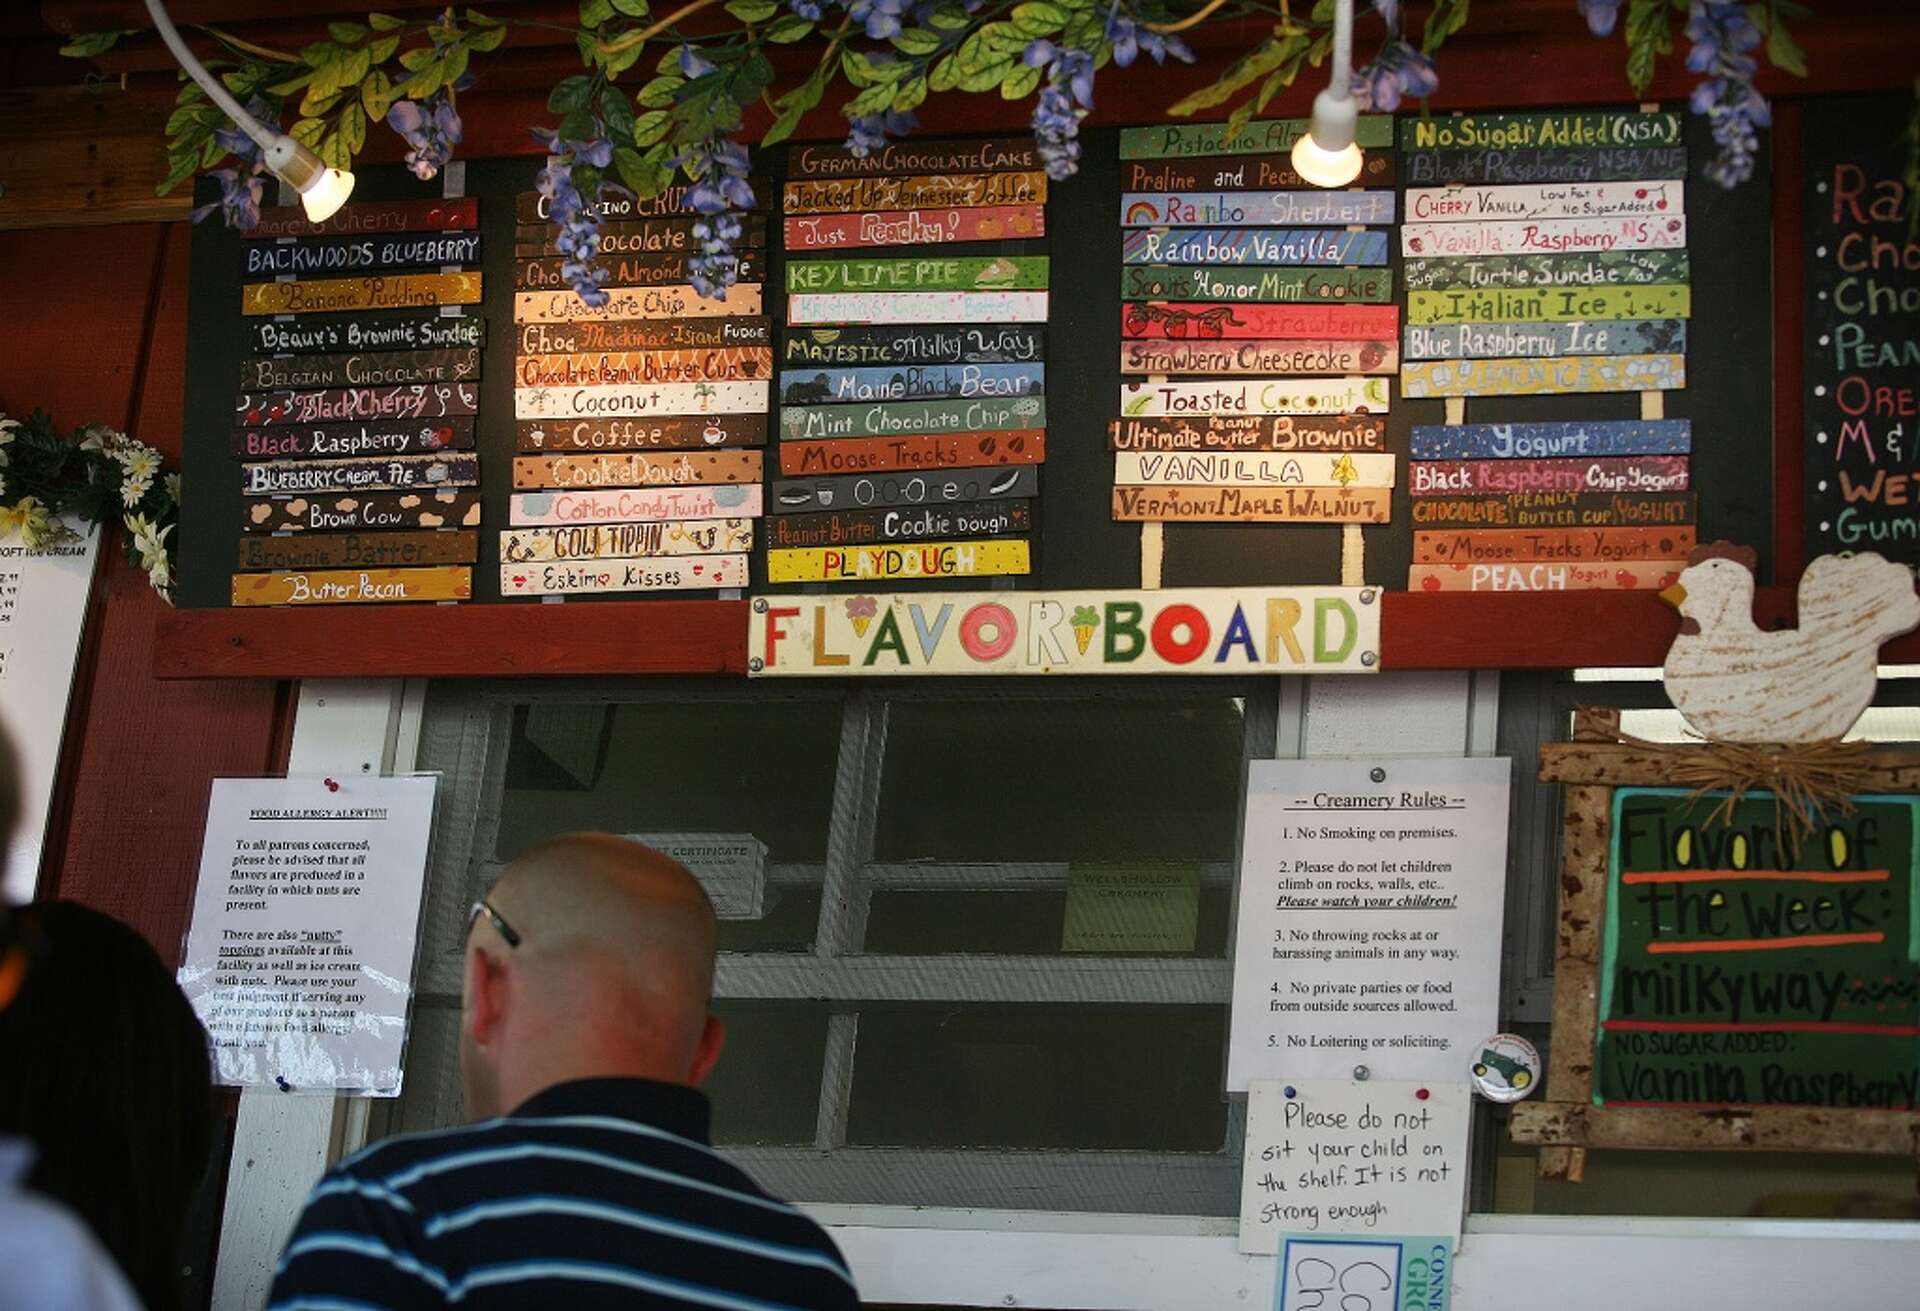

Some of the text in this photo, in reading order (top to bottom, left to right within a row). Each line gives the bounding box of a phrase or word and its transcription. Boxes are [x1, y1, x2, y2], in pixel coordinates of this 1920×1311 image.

[1416, 116, 1677, 148] No Sugar Added (NSA)
[1132, 164, 1244, 192] Praline and
[1270, 193, 1383, 223] Sherbert
[1477, 192, 1527, 213] VANILLA
[798, 219, 846, 244] Just
[1426, 226, 1617, 251] Vanilla Raspberry
[248, 236, 479, 273] BACKWOODS BLUEBERRY
[1140, 234, 1344, 262] Rainbow Vanilla
[1194, 270, 1377, 300] Honor Mint Cookie
[1464, 258, 1619, 285] Turtle Sundae
[280, 276, 437, 310] Banana Pudding
[1447, 291, 1607, 320] Italian Ice
[349, 321, 479, 344] Brownie Sundae
[1411, 321, 1608, 357] Blue Raspberry Ice
[788, 330, 1036, 364] MAJESTIC Milky Way
[1128, 345, 1230, 372] Strawberry
[256, 358, 444, 387] BELGIAN CHOCOLATE
[838, 366, 1028, 399] Maine Black Bear
[573, 388, 660, 413] Coconut
[1158, 384, 1357, 411] Toasted Coconut
[573, 422, 663, 447] Coffee
[803, 403, 1009, 438] Mint Chocolate Chip
[1114, 417, 1377, 448] Ultimate Peanut Butter Brownie
[247, 428, 409, 455] Black Raspberry
[1492, 425, 1589, 457] Yogurt
[801, 442, 958, 472] Moose Tracks
[1140, 456, 1303, 482] VANILLA
[552, 458, 632, 486] Cookie
[1416, 465, 1688, 491] Black Raspberry Chip Yogurt
[556, 494, 715, 521] Cotton Candy Twist
[1116, 487, 1376, 517] VERMONT MAPLE WALNUT
[1412, 501, 1508, 524] CHOCOLATE
[1519, 511, 1576, 524] BUTTER
[1583, 512, 1611, 523] CUP
[884, 511, 950, 537] Cookie
[554, 528, 601, 558] COW
[1450, 533, 1648, 561] Moose Tracks Yogurt
[623, 566, 680, 587] Kisses
[823, 548, 976, 578] PLAYDOUGH
[283, 574, 407, 602] Butter Pecan
[1471, 566, 1608, 591] PEACH Yogurt
[766, 598, 1358, 666] FLAVOR BOARD
[1313, 791, 1447, 809] Creamery Rules
[1297, 827, 1457, 841] No Smoking on premises.
[1295, 860, 1452, 873] Please do not let children
[1276, 895, 1318, 907] Please
[1321, 895, 1359, 907] watch
[1363, 898, 1393, 909] your
[1637, 881, 1729, 936] the
[1289, 929, 1406, 944] No throwing rocks
[1290, 981, 1452, 996] No private parties food
[1270, 999, 1456, 1011] from outside sources allowed.
[1287, 1035, 1451, 1050] No Loitering soliciting.
[1615, 1034, 1645, 1054] NO
[1649, 1033, 1714, 1054] SUGAR
[1284, 1102, 1432, 1130] Please do not
[1261, 1135, 1443, 1164] sit your child on
[1257, 1162, 1451, 1192] the shelf. It is not
[1260, 1201, 1388, 1231] strong enough
